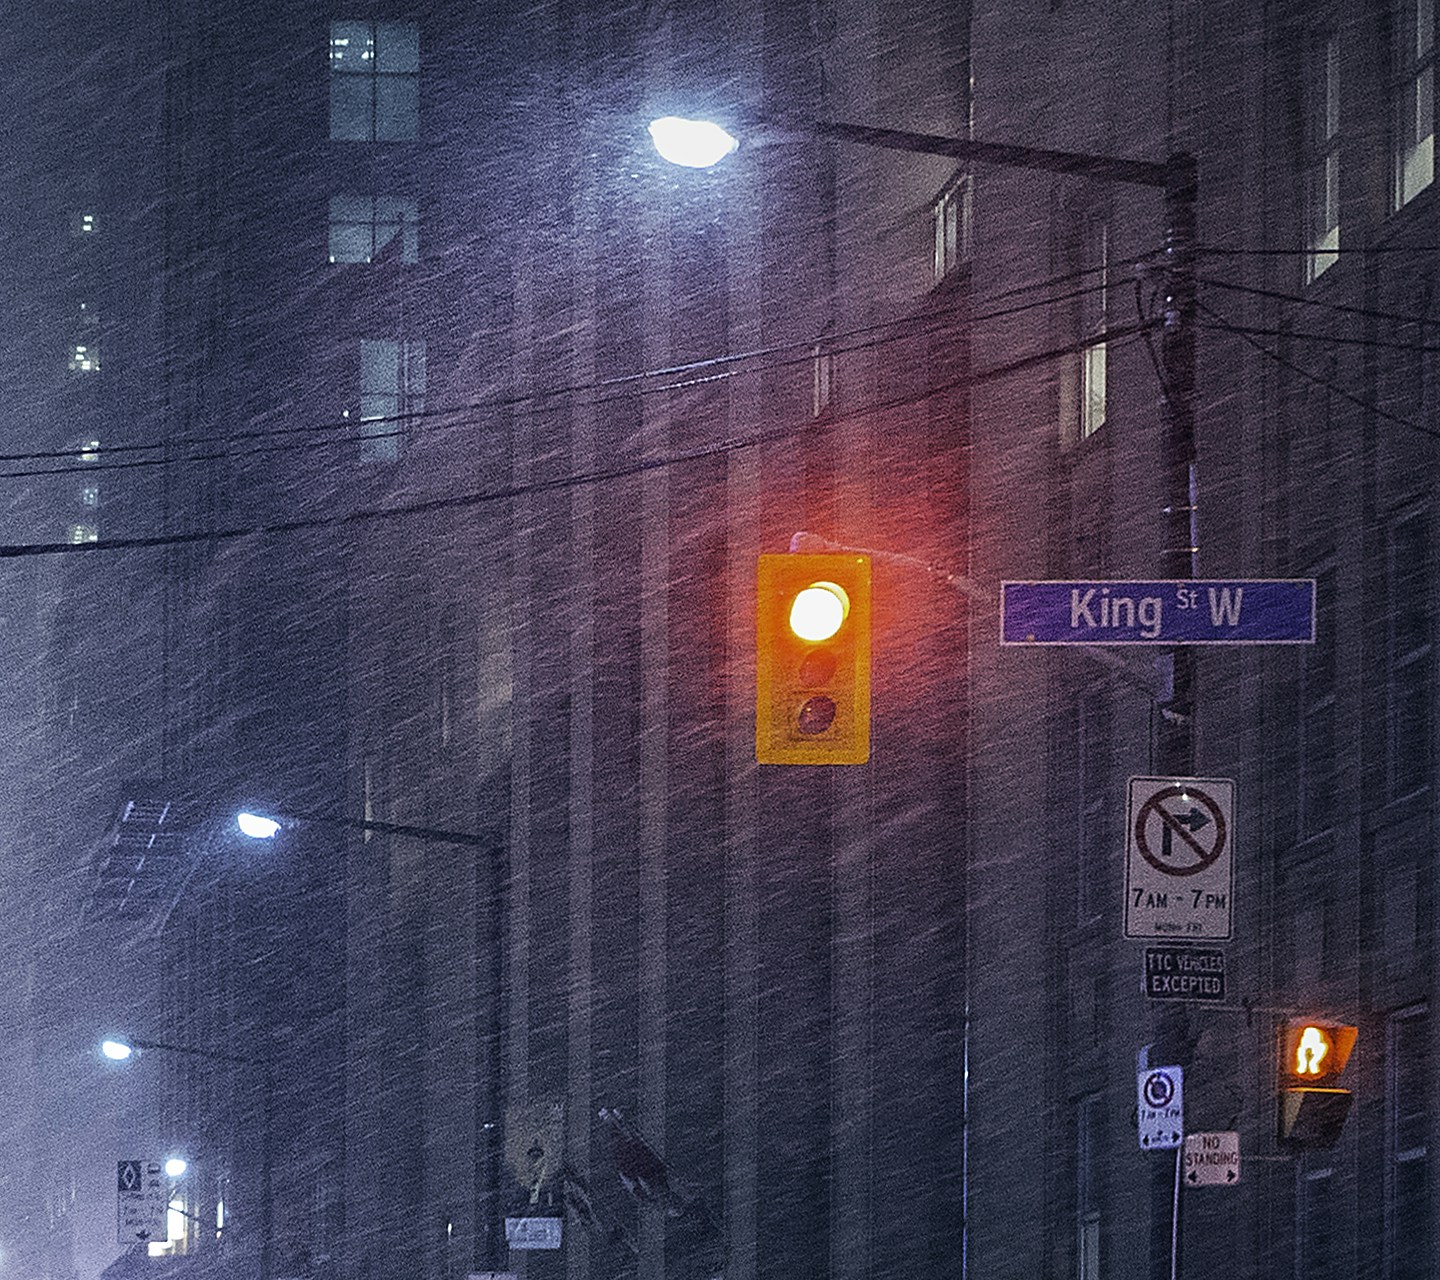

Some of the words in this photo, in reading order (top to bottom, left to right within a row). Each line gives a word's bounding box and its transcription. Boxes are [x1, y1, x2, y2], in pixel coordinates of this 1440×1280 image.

[1069, 587, 1163, 639] King
[1175, 588, 1199, 610] St
[1207, 587, 1245, 627] W
[1147, 953, 1172, 970] TTC
[1151, 975, 1221, 994] EXCEPTED
[1202, 1135, 1220, 1150] NO
[1186, 1151, 1238, 1167] STANDING
